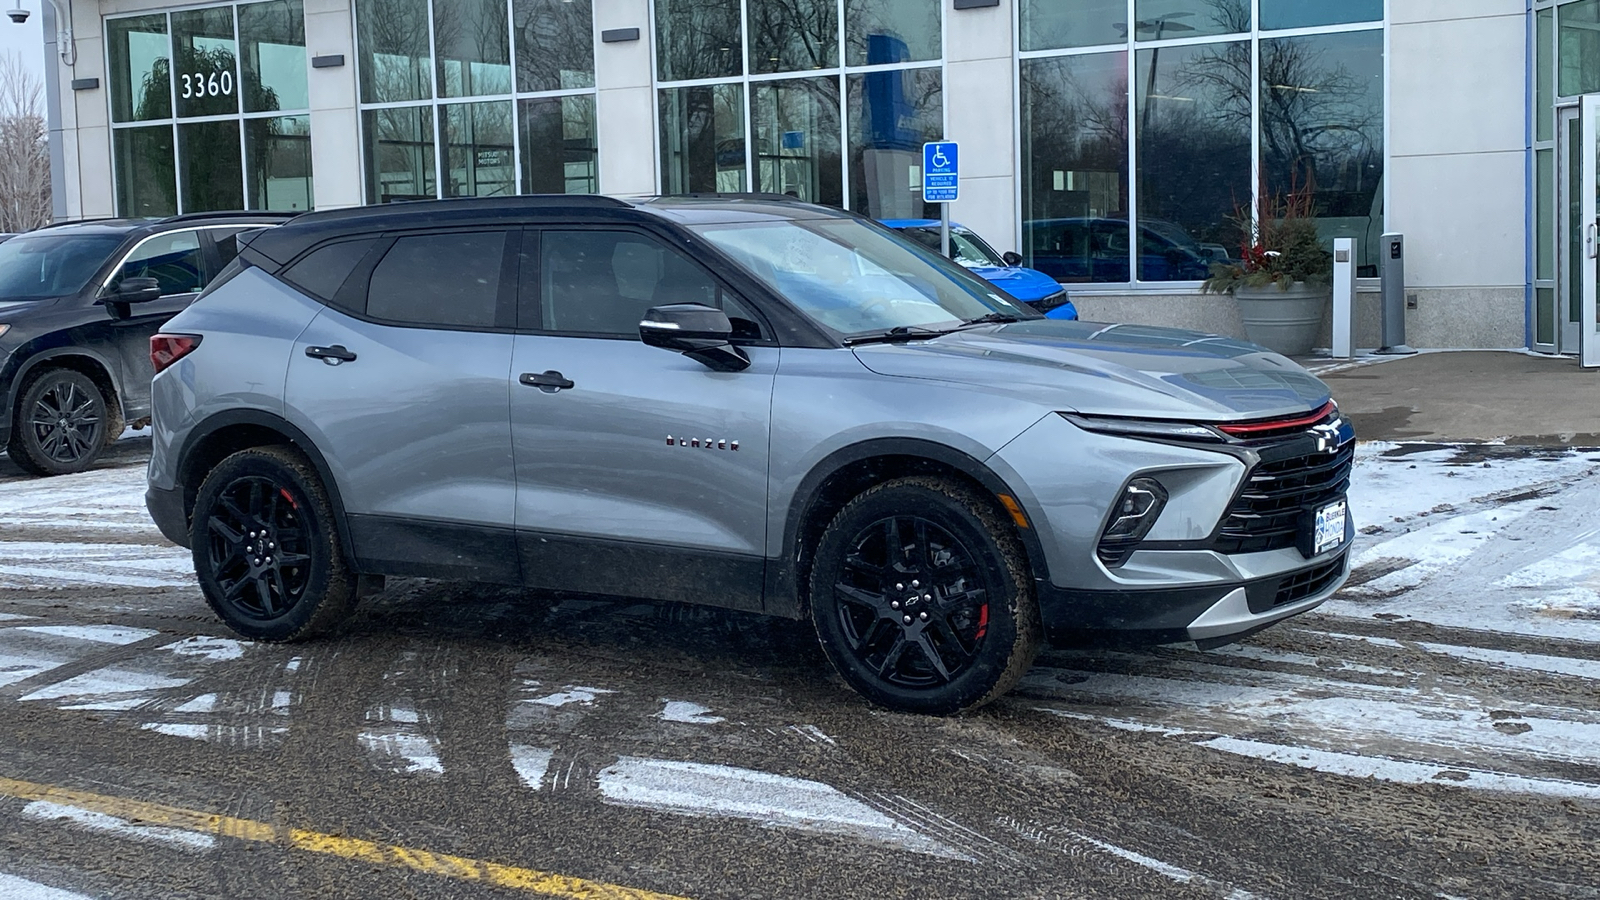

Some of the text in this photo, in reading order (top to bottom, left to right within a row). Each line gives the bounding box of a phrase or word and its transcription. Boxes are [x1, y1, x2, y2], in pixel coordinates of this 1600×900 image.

[181, 70, 232, 98] 3360
[666, 434, 740, 452] BLAZER
[1326, 507, 1346, 523] BUERKLE
[1324, 519, 1344, 539] HONDA
